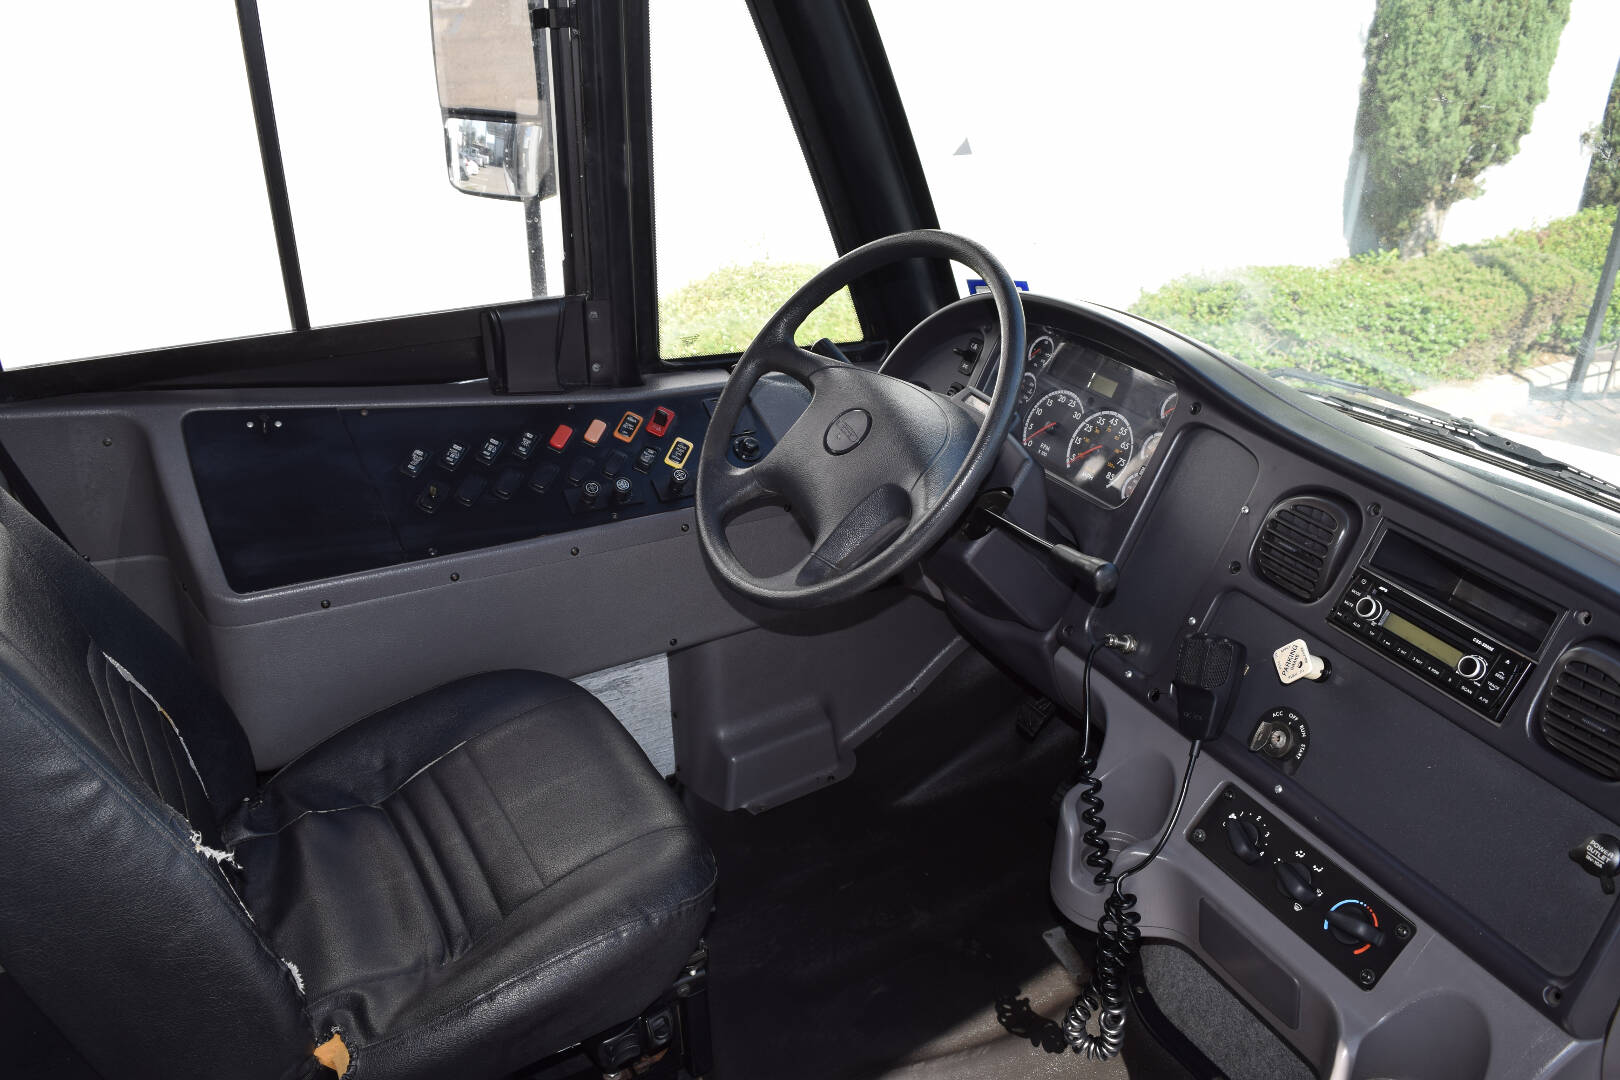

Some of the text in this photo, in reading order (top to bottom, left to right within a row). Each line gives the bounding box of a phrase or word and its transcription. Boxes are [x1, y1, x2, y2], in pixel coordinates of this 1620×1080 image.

[1046, 398, 1054, 407] 15
[1057, 394, 1067, 403] 20
[1067, 399, 1077, 408] 25
[1035, 407, 1043, 416] 10
[1072, 411, 1082, 420] 30
[1097, 416, 1106, 426] 35
[1108, 417, 1119, 426] 45
[1084, 423, 1093, 433] 25
[1119, 426, 1129, 436] 55
[1074, 436, 1082, 445] 15
[1120, 441, 1130, 450] 65
[1116, 456, 1126, 467] 75
[1106, 472, 1115, 480] 85
[1282, 644, 1298, 676] PARKING
[1461, 685, 1473, 695] SCAN
[1272, 710, 1284, 718] ACC
[1288, 712, 1299, 721] OFF
[1299, 724, 1307, 738] RUN
[1295, 743, 1306, 760] START
[1590, 839, 1613, 858] POWER
[1586, 845, 1610, 863] OUTLET
